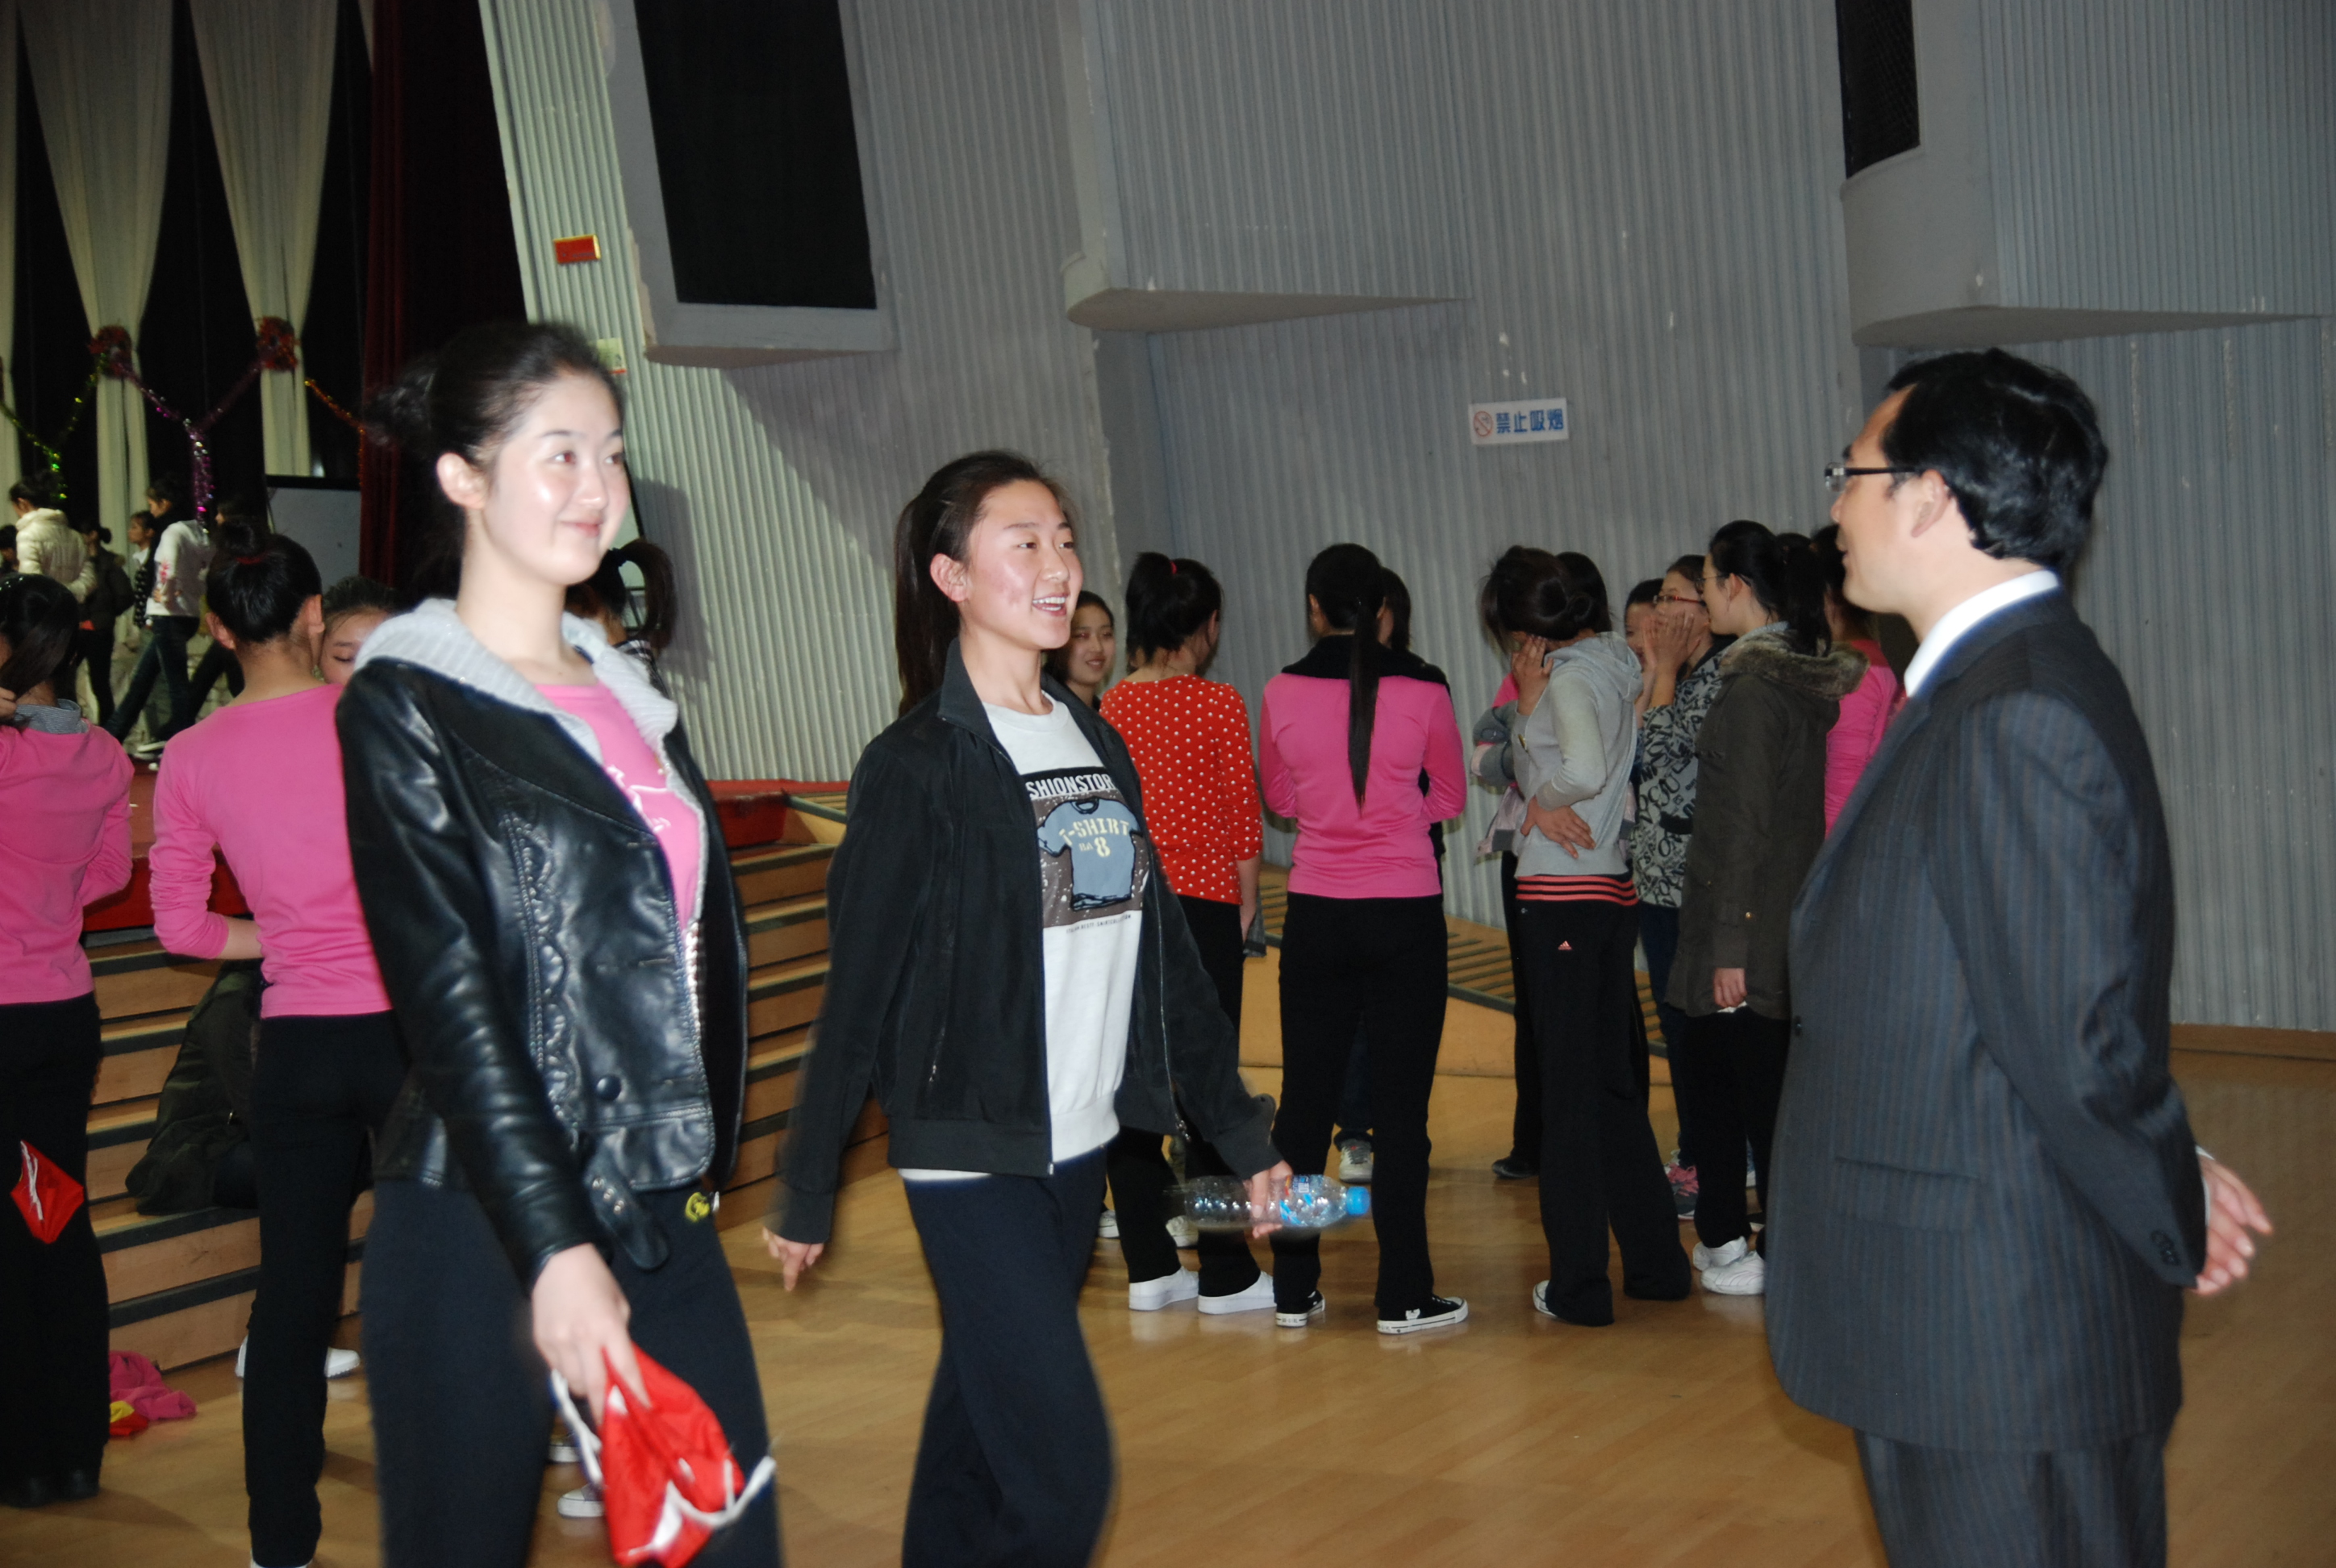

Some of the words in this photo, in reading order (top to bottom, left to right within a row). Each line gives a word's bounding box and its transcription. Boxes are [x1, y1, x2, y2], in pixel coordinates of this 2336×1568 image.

[1495, 408, 1563, 434] 禁止吸烟
[1058, 817, 1129, 846] T-SHIRT
[1094, 836, 1111, 857] 8
